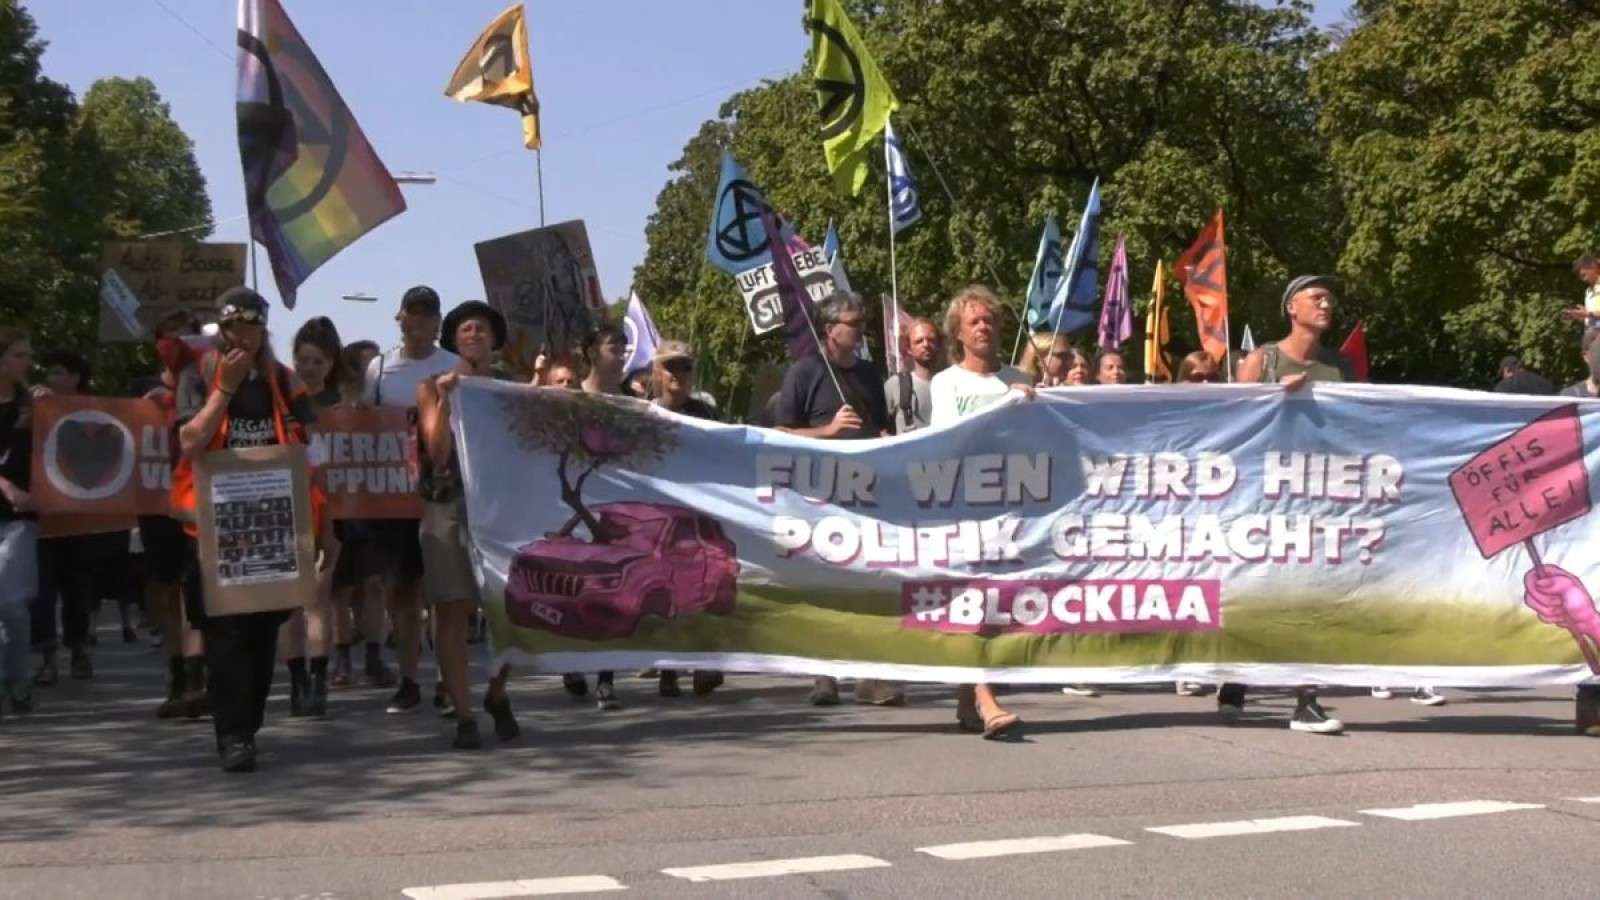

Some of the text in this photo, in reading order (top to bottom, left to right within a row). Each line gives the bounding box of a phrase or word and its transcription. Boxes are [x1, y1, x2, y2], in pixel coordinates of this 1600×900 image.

[740, 250, 825, 293] LUFT EBE
[908, 453, 1053, 508] WEN
[1081, 452, 1237, 501] WIRD
[1263, 451, 1403, 502] HIER
[772, 512, 1385, 568] POLITIK GEMACHT?
[911, 583, 1212, 625] #BLOCKIAA
